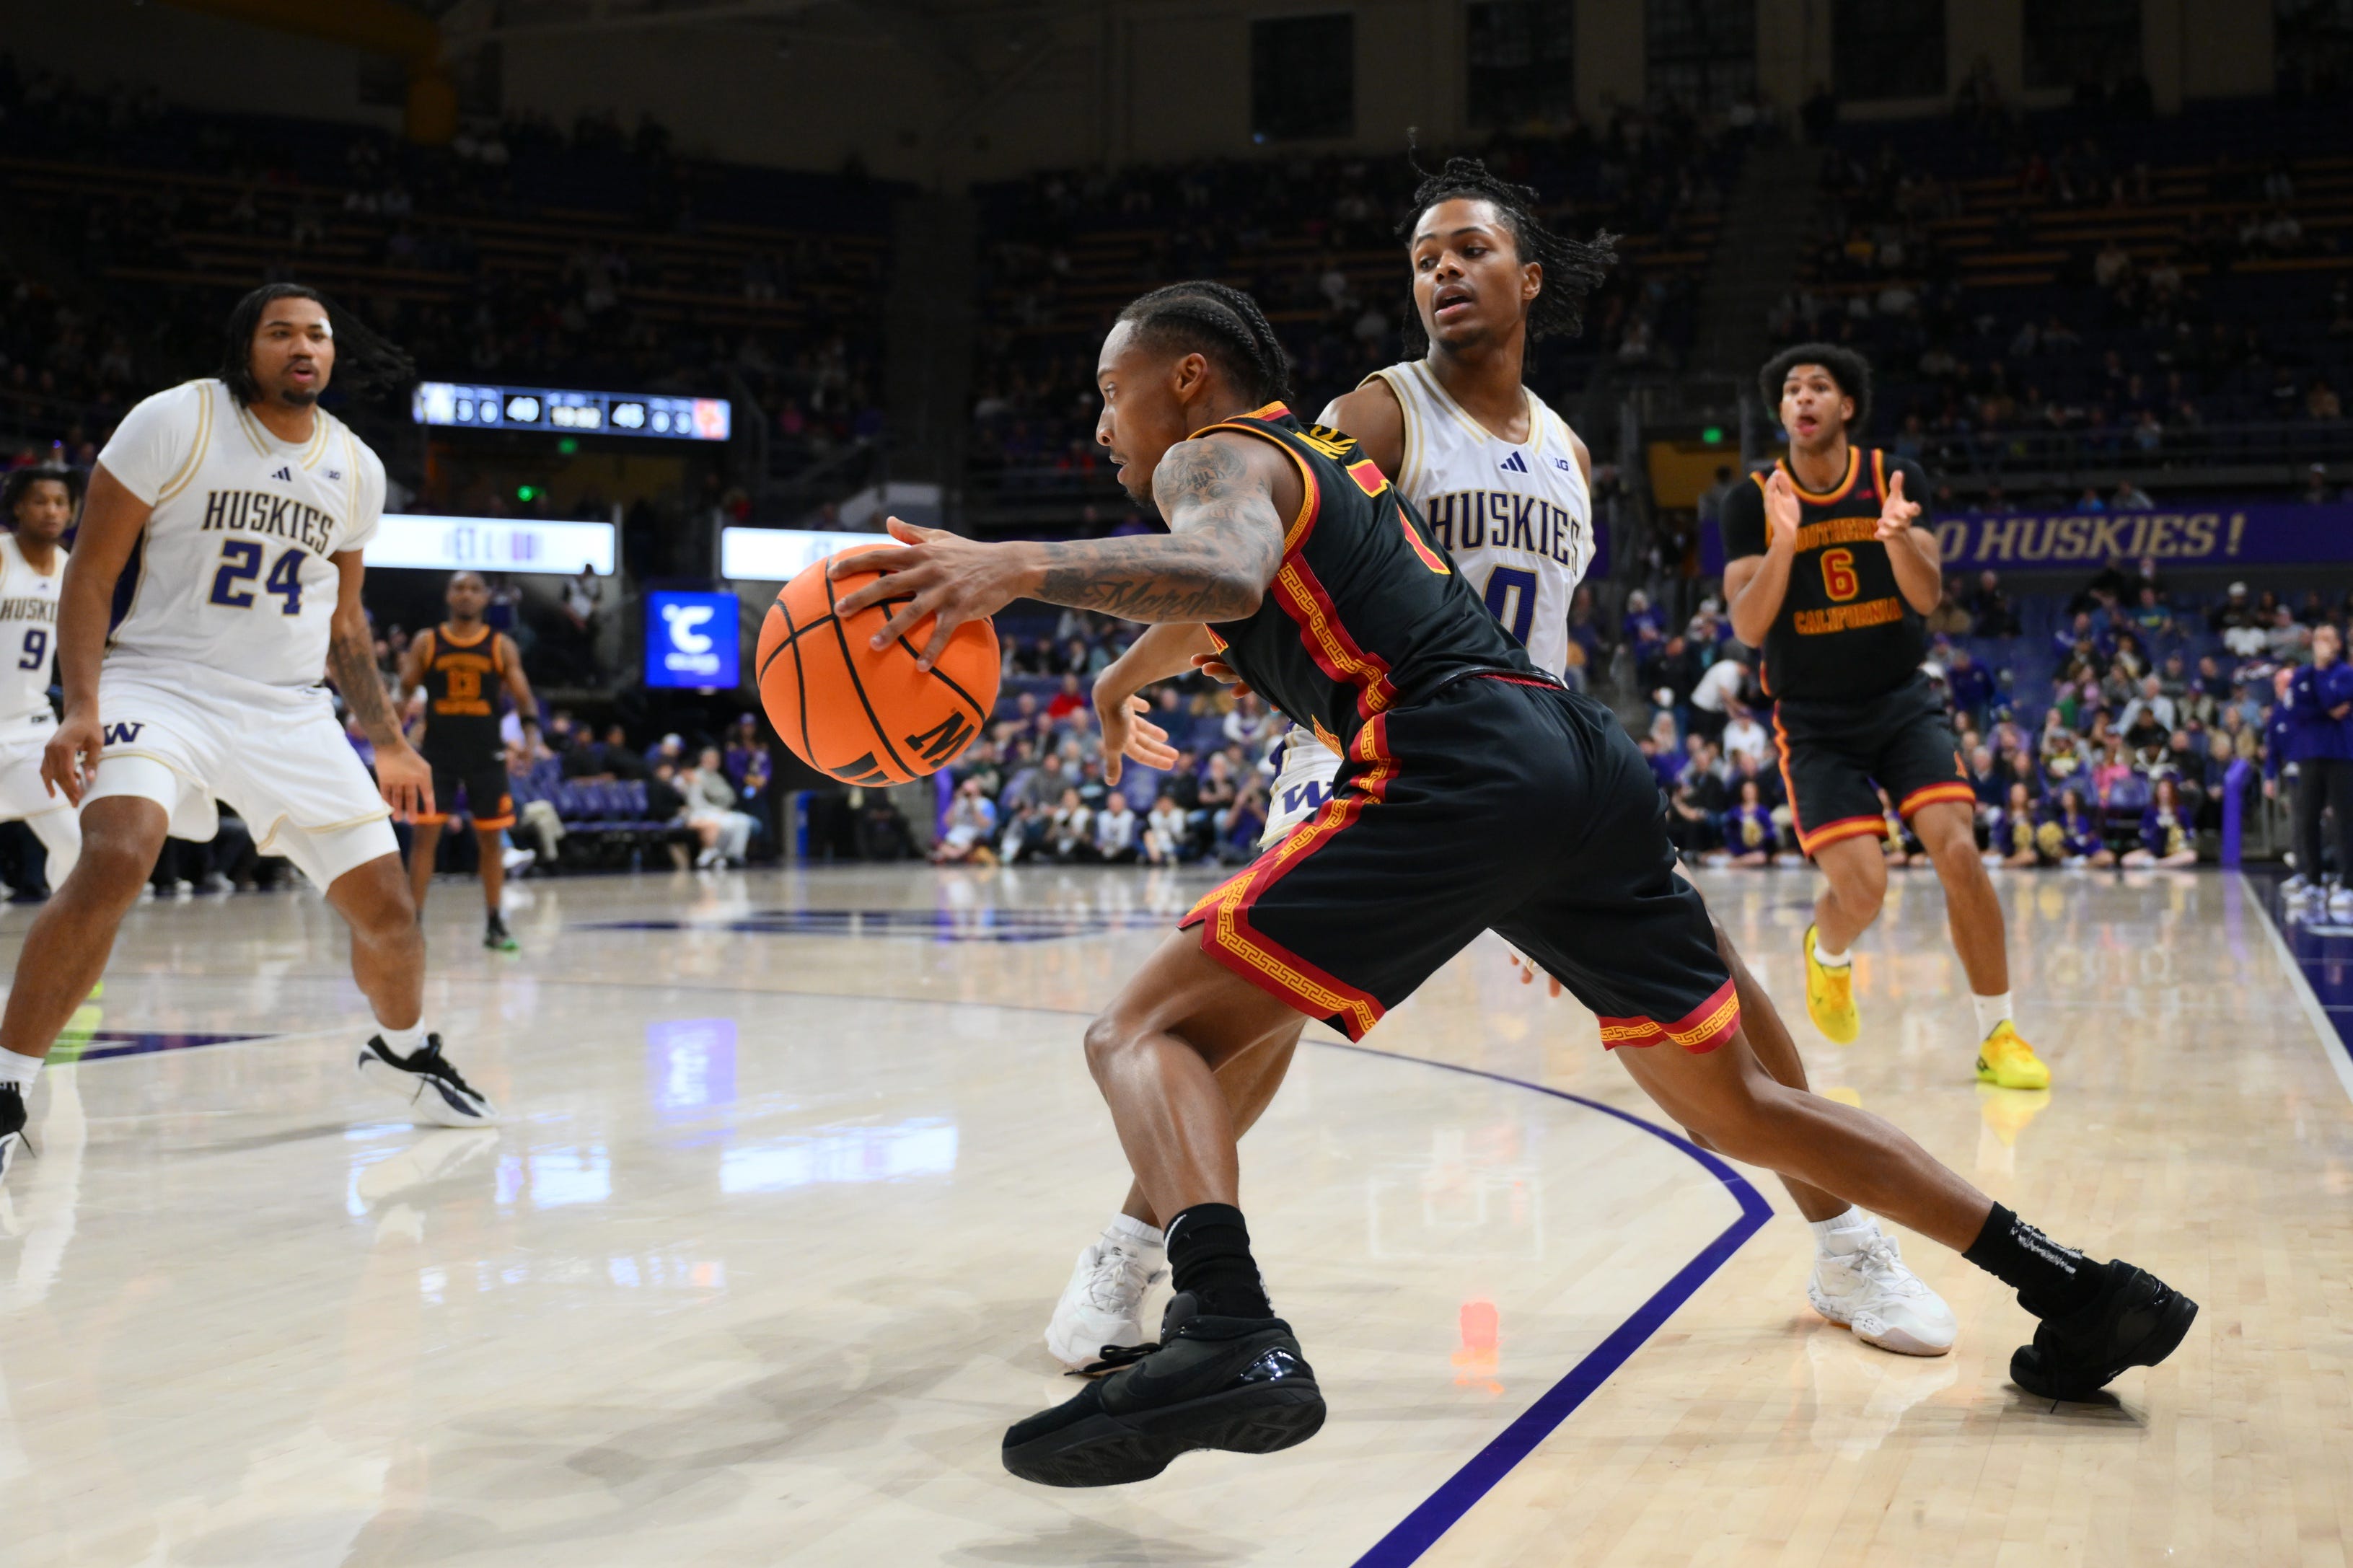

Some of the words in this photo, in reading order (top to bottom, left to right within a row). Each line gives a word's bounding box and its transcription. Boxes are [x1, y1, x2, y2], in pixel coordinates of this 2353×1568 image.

[201, 490, 334, 555] HUSKIES
[1428, 489, 1581, 577] HUSKIES
[207, 538, 309, 616] 24
[1821, 547, 1859, 602] 6
[1481, 563, 1539, 649] 0
[1793, 596, 1904, 635] CALIFORNIA
[18, 628, 48, 671] 9
[103, 722, 145, 746] W
[1281, 780, 1334, 815] W
